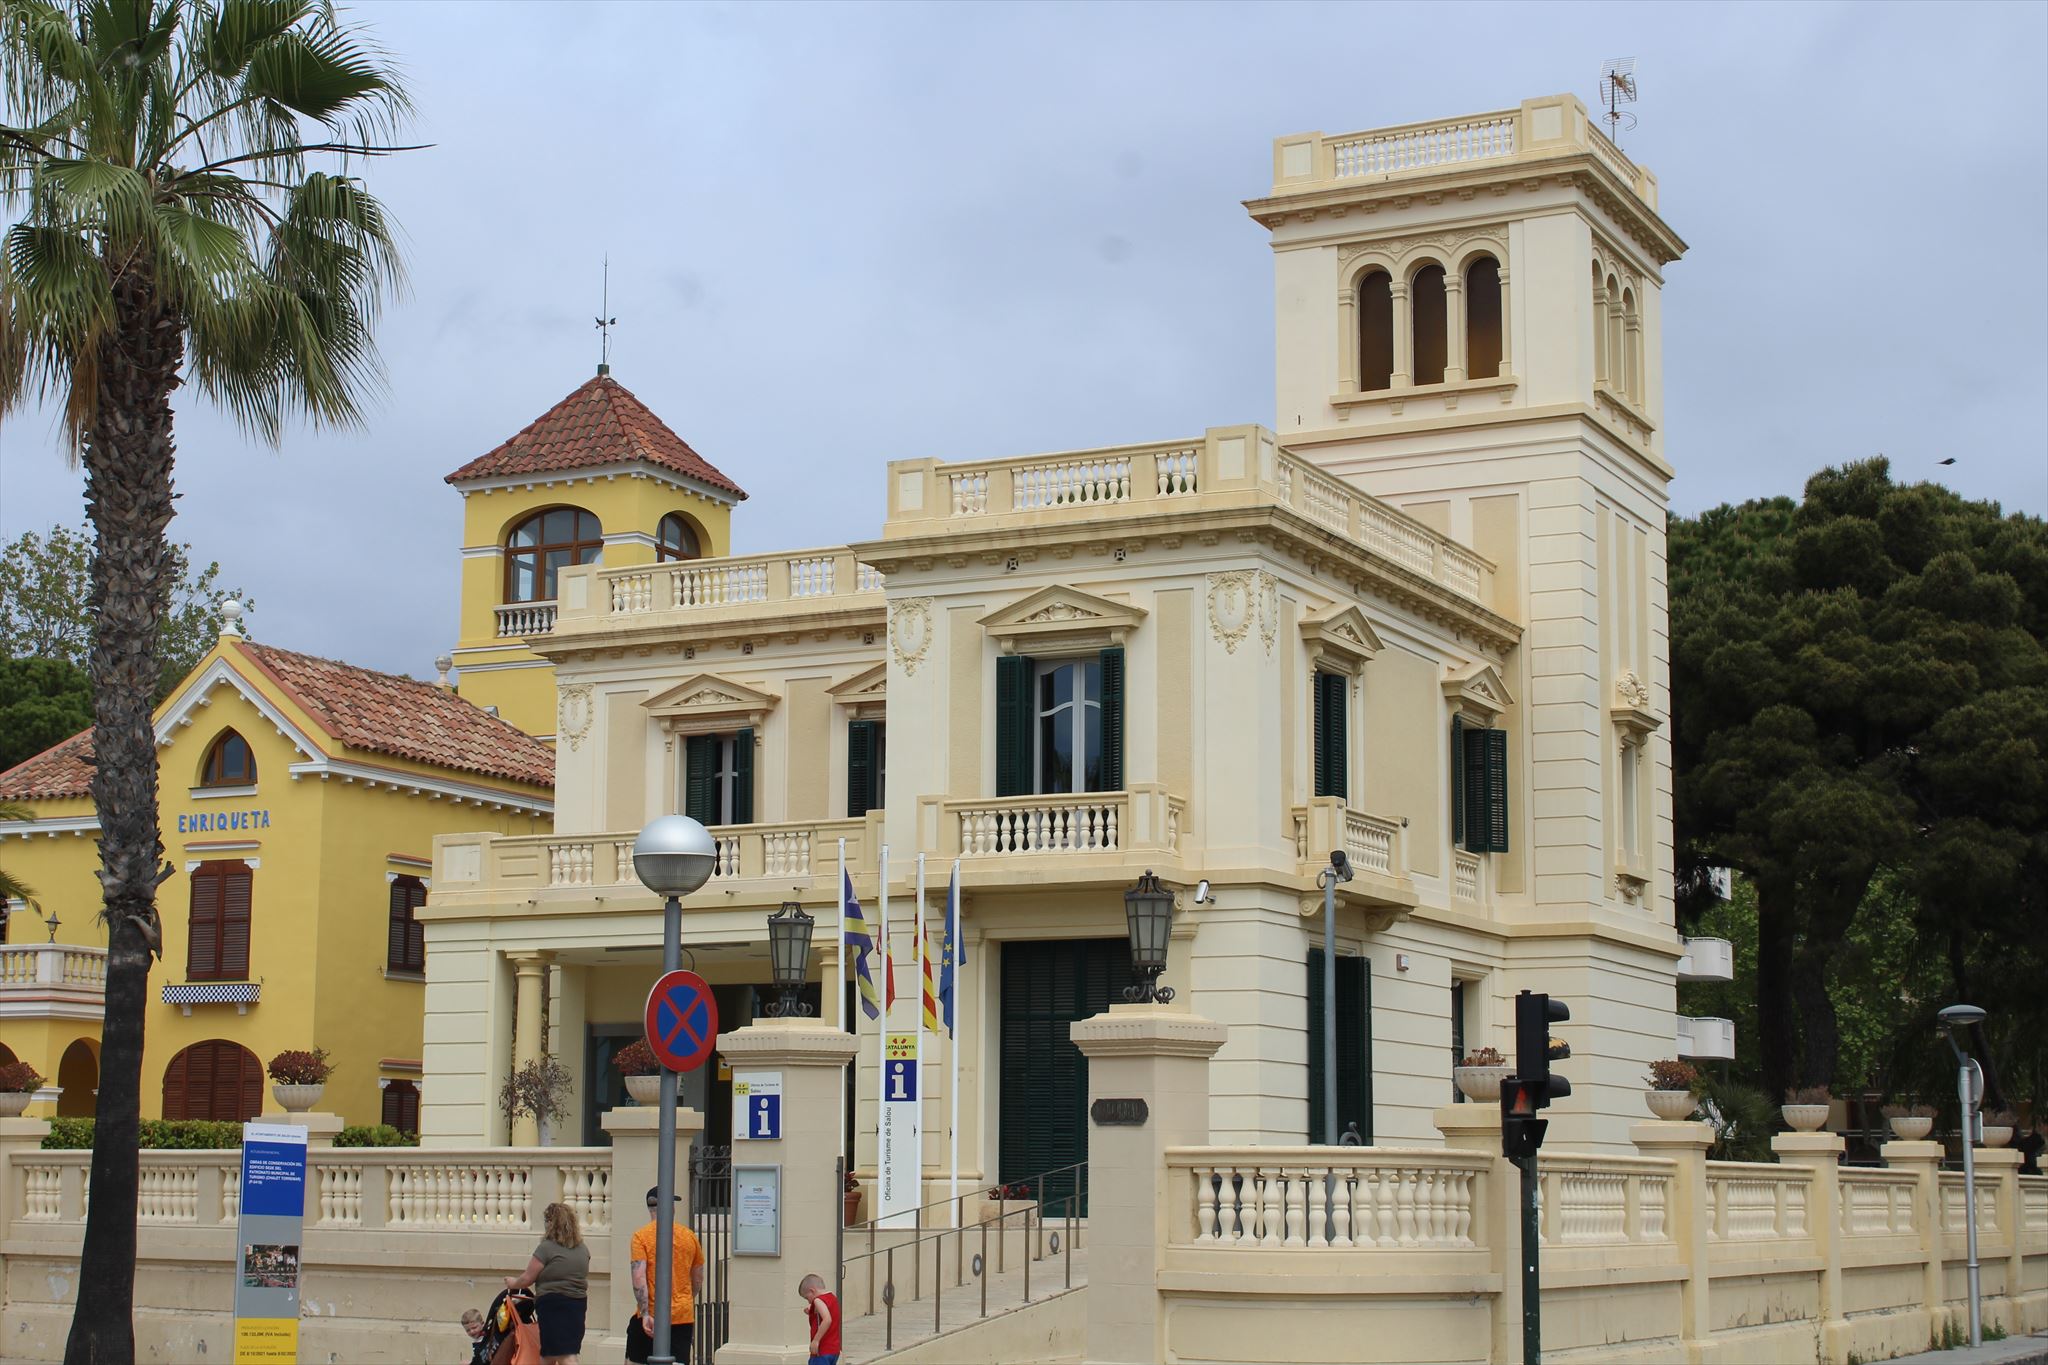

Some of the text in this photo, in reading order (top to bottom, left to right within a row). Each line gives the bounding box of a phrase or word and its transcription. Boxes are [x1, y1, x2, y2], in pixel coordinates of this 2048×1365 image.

[179, 810, 270, 833] ENRIQUETA
[885, 1128, 891, 1137] de
[885, 1166, 891, 1175] de
